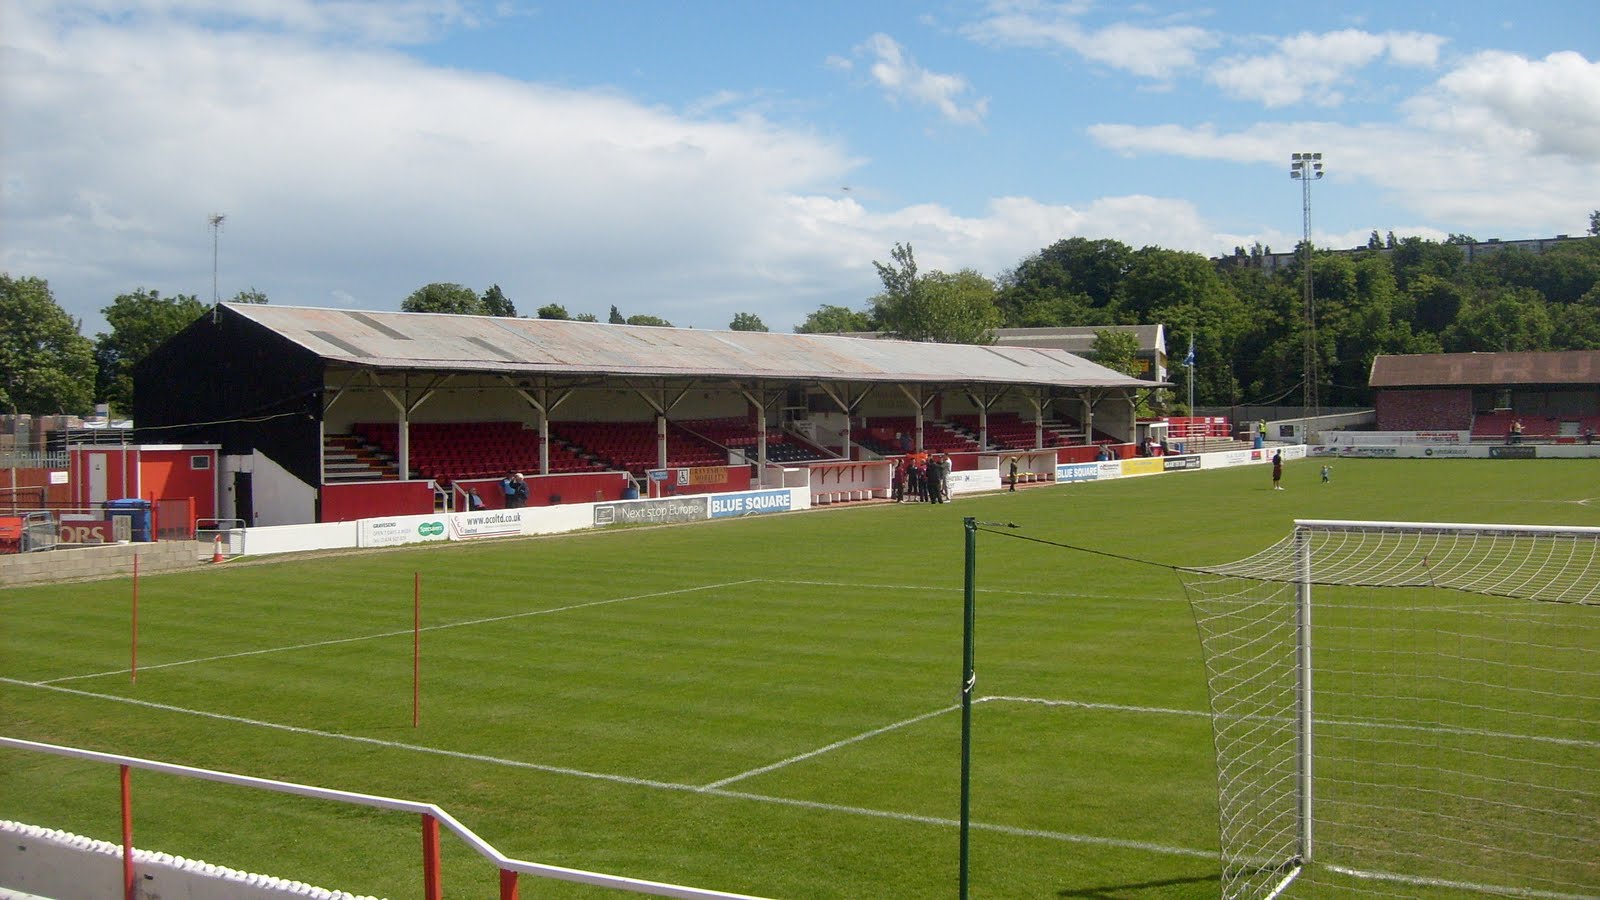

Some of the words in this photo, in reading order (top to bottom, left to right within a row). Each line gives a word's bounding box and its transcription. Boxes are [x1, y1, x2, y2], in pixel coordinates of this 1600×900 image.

[1057, 467, 1074, 478] BLUE
[1074, 466, 1098, 477] SQUARE
[712, 499, 743, 513] BLUE
[745, 494, 790, 510] SQUARE
[622, 508, 645, 519] Next
[647, 506, 667, 518] stop
[669, 505, 699, 517] Europe
[467, 513, 521, 525] www.ocoltd.co.uk
